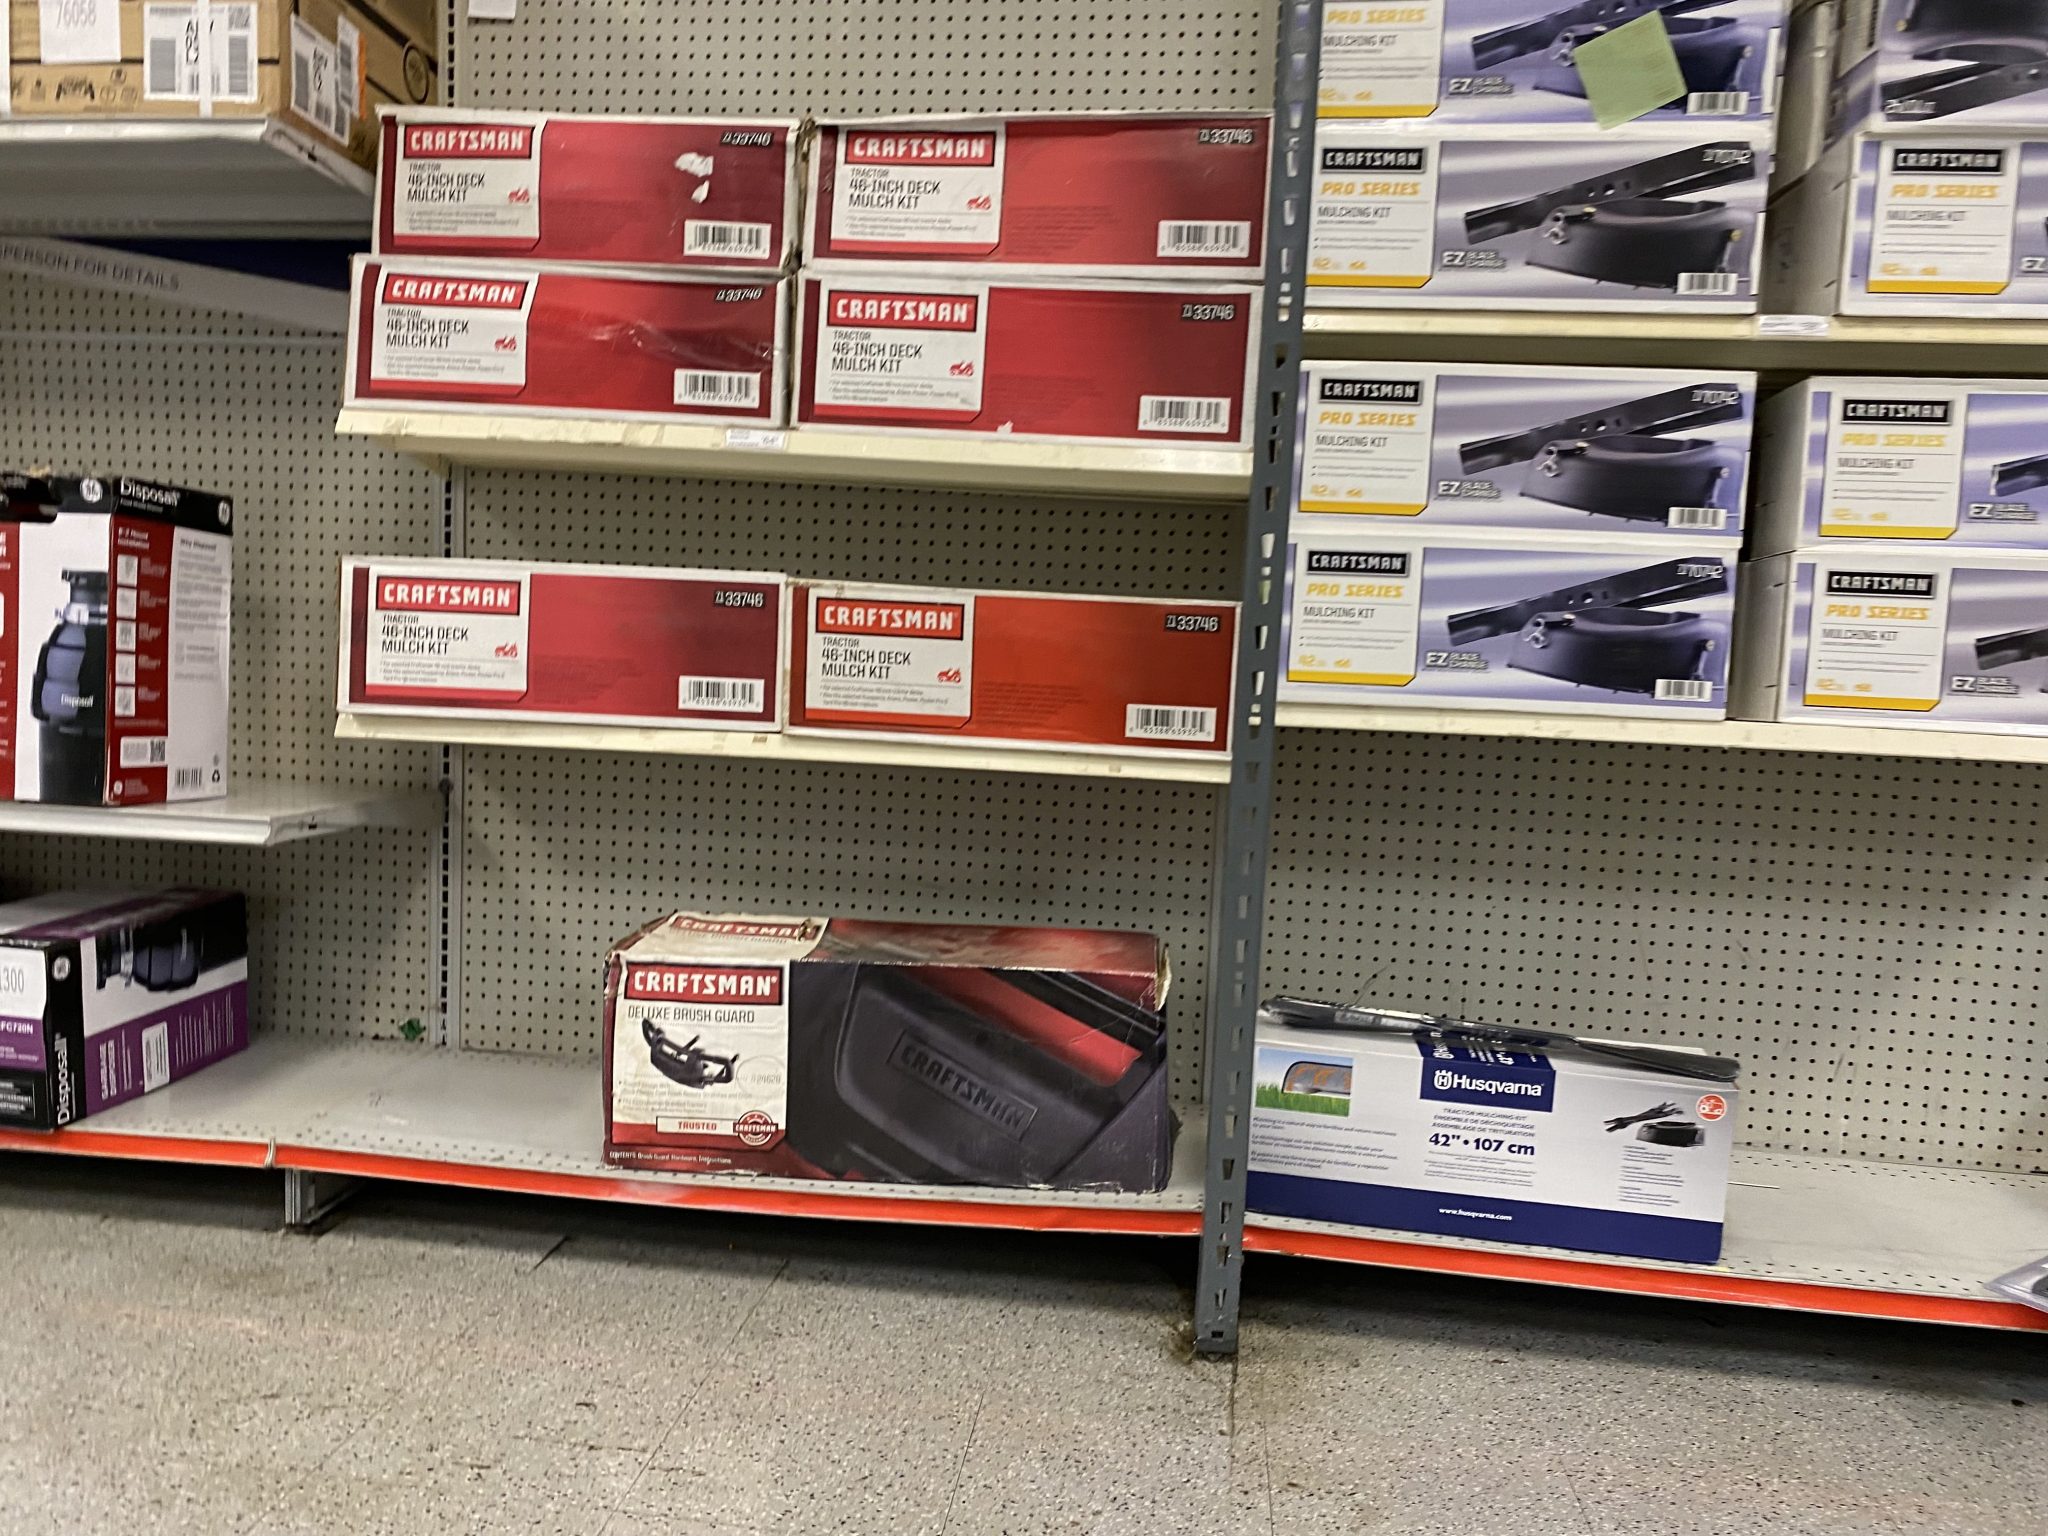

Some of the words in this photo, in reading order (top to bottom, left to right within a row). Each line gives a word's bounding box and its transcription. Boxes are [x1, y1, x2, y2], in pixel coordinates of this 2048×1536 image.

[1327, 9, 1361, 23] PRO
[1366, 8, 1425, 22] SERIES
[1323, 34, 1378, 47] MULCHING
[1379, 34, 1398, 46] KIT
[1450, 78, 1472, 93] EZ
[411, 130, 524, 151] CRAFTSMAN
[852, 137, 986, 158] CRAFTSMAN
[1325, 152, 1420, 166] CRAFTSMAN
[1896, 153, 2000, 168] CRAFTSMAN
[408, 173, 454, 188] 46-INCH
[456, 173, 485, 188] DECK
[850, 168, 890, 178] TRACTOR
[849, 179, 904, 194] 46-INCH
[907, 180, 942, 195] DECK
[1320, 181, 1356, 196] PRO
[1359, 181, 1421, 196] SERIES
[1892, 184, 1929, 198] PRO
[1933, 184, 2000, 198] SERIES
[407, 189, 447, 203] MULCH
[449, 190, 468, 203] KIT
[849, 194, 894, 209] MULCH
[897, 195, 920, 210] KIT
[1317, 206, 1373, 218] MULCHING
[1374, 206, 1392, 218] KIT
[1442, 251, 1465, 266] EZ
[2020, 257, 2047, 272] EZ
[111, 264, 180, 291] DETAILS
[391, 279, 517, 303] CRAFTSMAN
[836, 298, 968, 323] CRAFTSMAN
[386, 319, 436, 334] 46-INCH
[438, 320, 469, 335] DECK
[386, 334, 429, 348] MULCH
[430, 335, 451, 349] KIT
[833, 330, 872, 341] TRACTOR
[832, 341, 886, 357] 46-INCH
[888, 343, 923, 359] DECK
[831, 356, 876, 372] MULCH
[879, 358, 902, 374] KIT
[1323, 383, 1417, 398] CRAFTSMAN
[1846, 404, 1947, 418] CRAFTSMAN
[1318, 411, 1353, 425] PRO
[1357, 412, 1418, 427] SERIES
[1315, 435, 1369, 447] MULCHING
[1370, 436, 1389, 447] KIT
[1841, 433, 1879, 446] PRO
[1883, 434, 1948, 447] SERIES
[1438, 481, 1461, 496] EZ
[1968, 503, 1993, 518] EZ
[1311, 555, 1403, 570] CRAFTSMAN
[1306, 583, 1341, 596] PRO
[1344, 584, 1405, 598] SERIES
[1831, 576, 1931, 591] CRAFTSMAN
[384, 583, 512, 607] CRAFTSMAN
[382, 614, 419, 624] TRACTOR
[824, 606, 953, 630] CRAFTSMAN
[1303, 606, 1357, 618] MULCHING
[1358, 607, 1376, 619] KIT
[1825, 604, 1861, 618] PRO
[1866, 606, 1930, 620] SERIES
[382, 625, 434, 641] 46-INCH
[437, 627, 469, 642] DECK
[382, 640, 425, 655] MULCH
[428, 641, 449, 655] KIT
[822, 636, 860, 647] TRACTOR
[821, 648, 875, 664] 46-INCH
[878, 651, 911, 666] DECK
[1425, 652, 1449, 667] EZ
[821, 663, 865, 678] MULCH
[869, 665, 892, 679] KIT
[1951, 677, 1976, 692] EZ
[0, 966, 25, 994] 300
[634, 970, 771, 996] CRAFTSMAN
[628, 1005, 670, 1020] DELUXE
[673, 1007, 712, 1022] BRUSH
[715, 1009, 755, 1023] GUARD
[901, 1045, 1026, 1129] CRAFTSMAN
[1452, 1073, 1542, 1097] Husqvarna
[677, 1121, 718, 1131] TRUSTED
[735, 1124, 777, 1133] CRAFTSMAN
[1429, 1133, 1461, 1147] 42"
[1473, 1138, 1505, 1152] 107
[1507, 1143, 1535, 1156] cm
[1438, 1208, 1513, 1221] www.husqvarna.com
